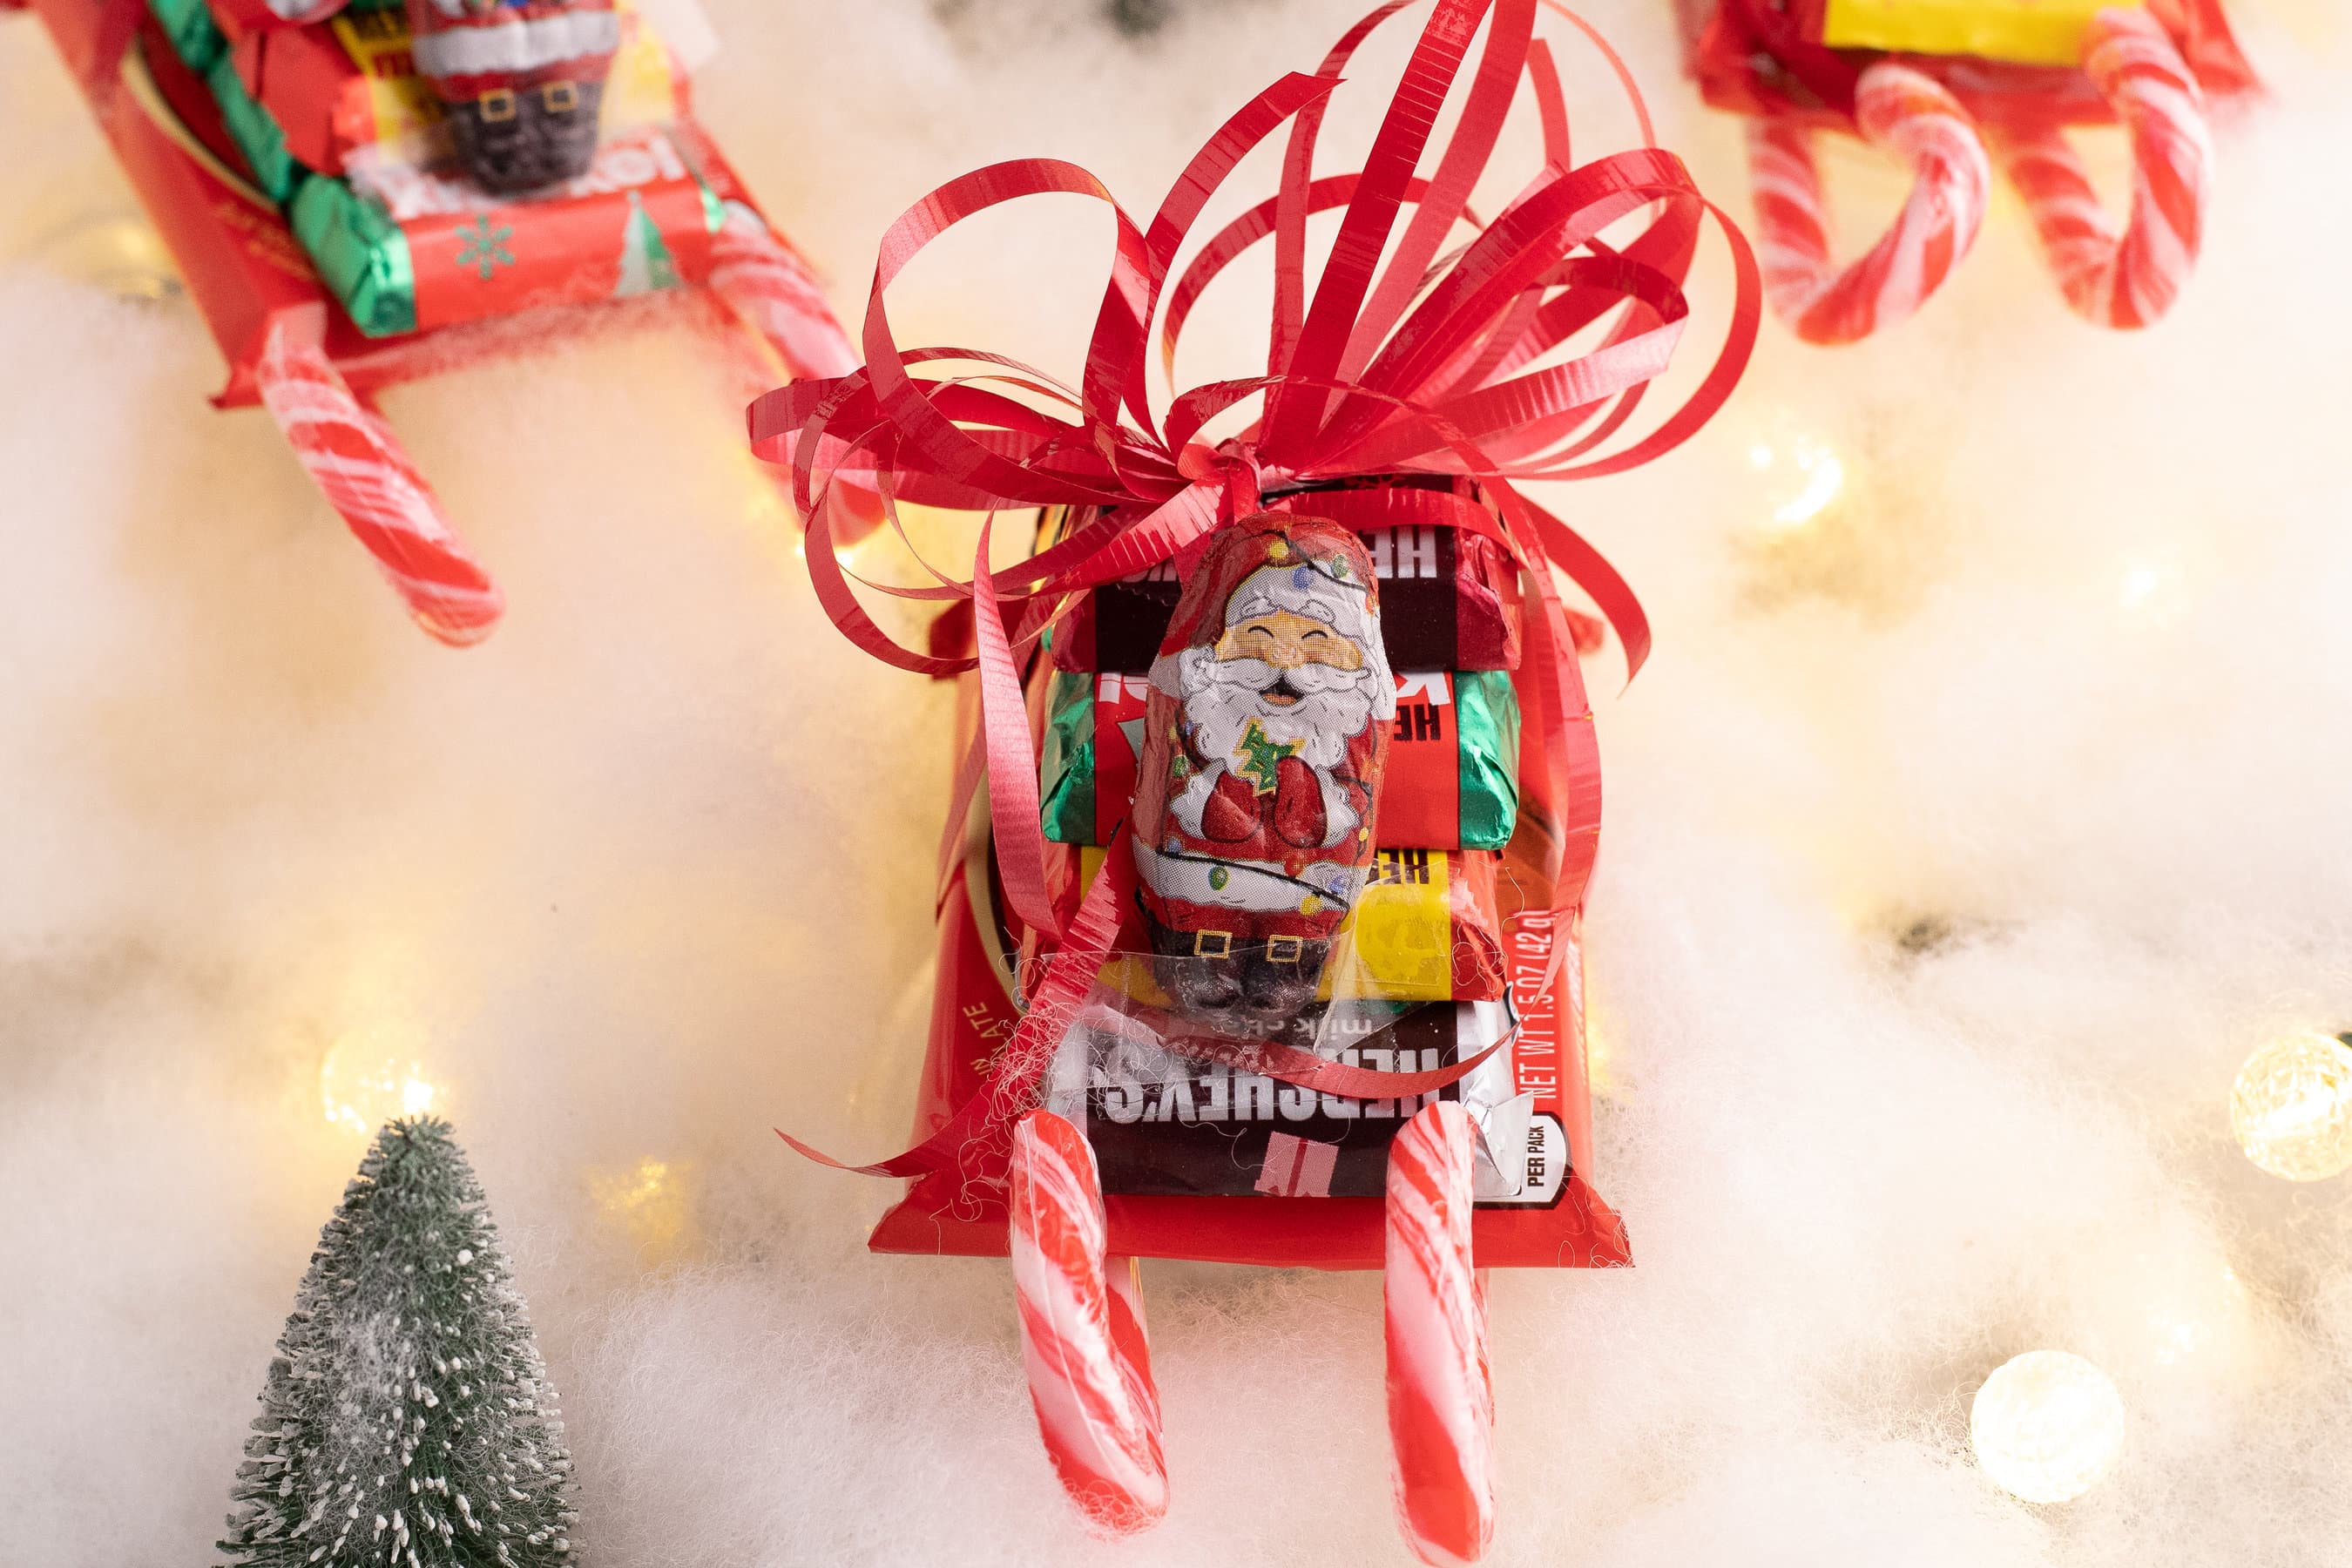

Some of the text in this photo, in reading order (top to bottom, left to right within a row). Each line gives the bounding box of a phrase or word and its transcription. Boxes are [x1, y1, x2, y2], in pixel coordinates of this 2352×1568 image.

[1515, 932, 1552, 959] (42
[1517, 1026, 1556, 1056] WT
[1519, 1062, 1557, 1099] NET
[1527, 1125, 1545, 1187] PER PACK
